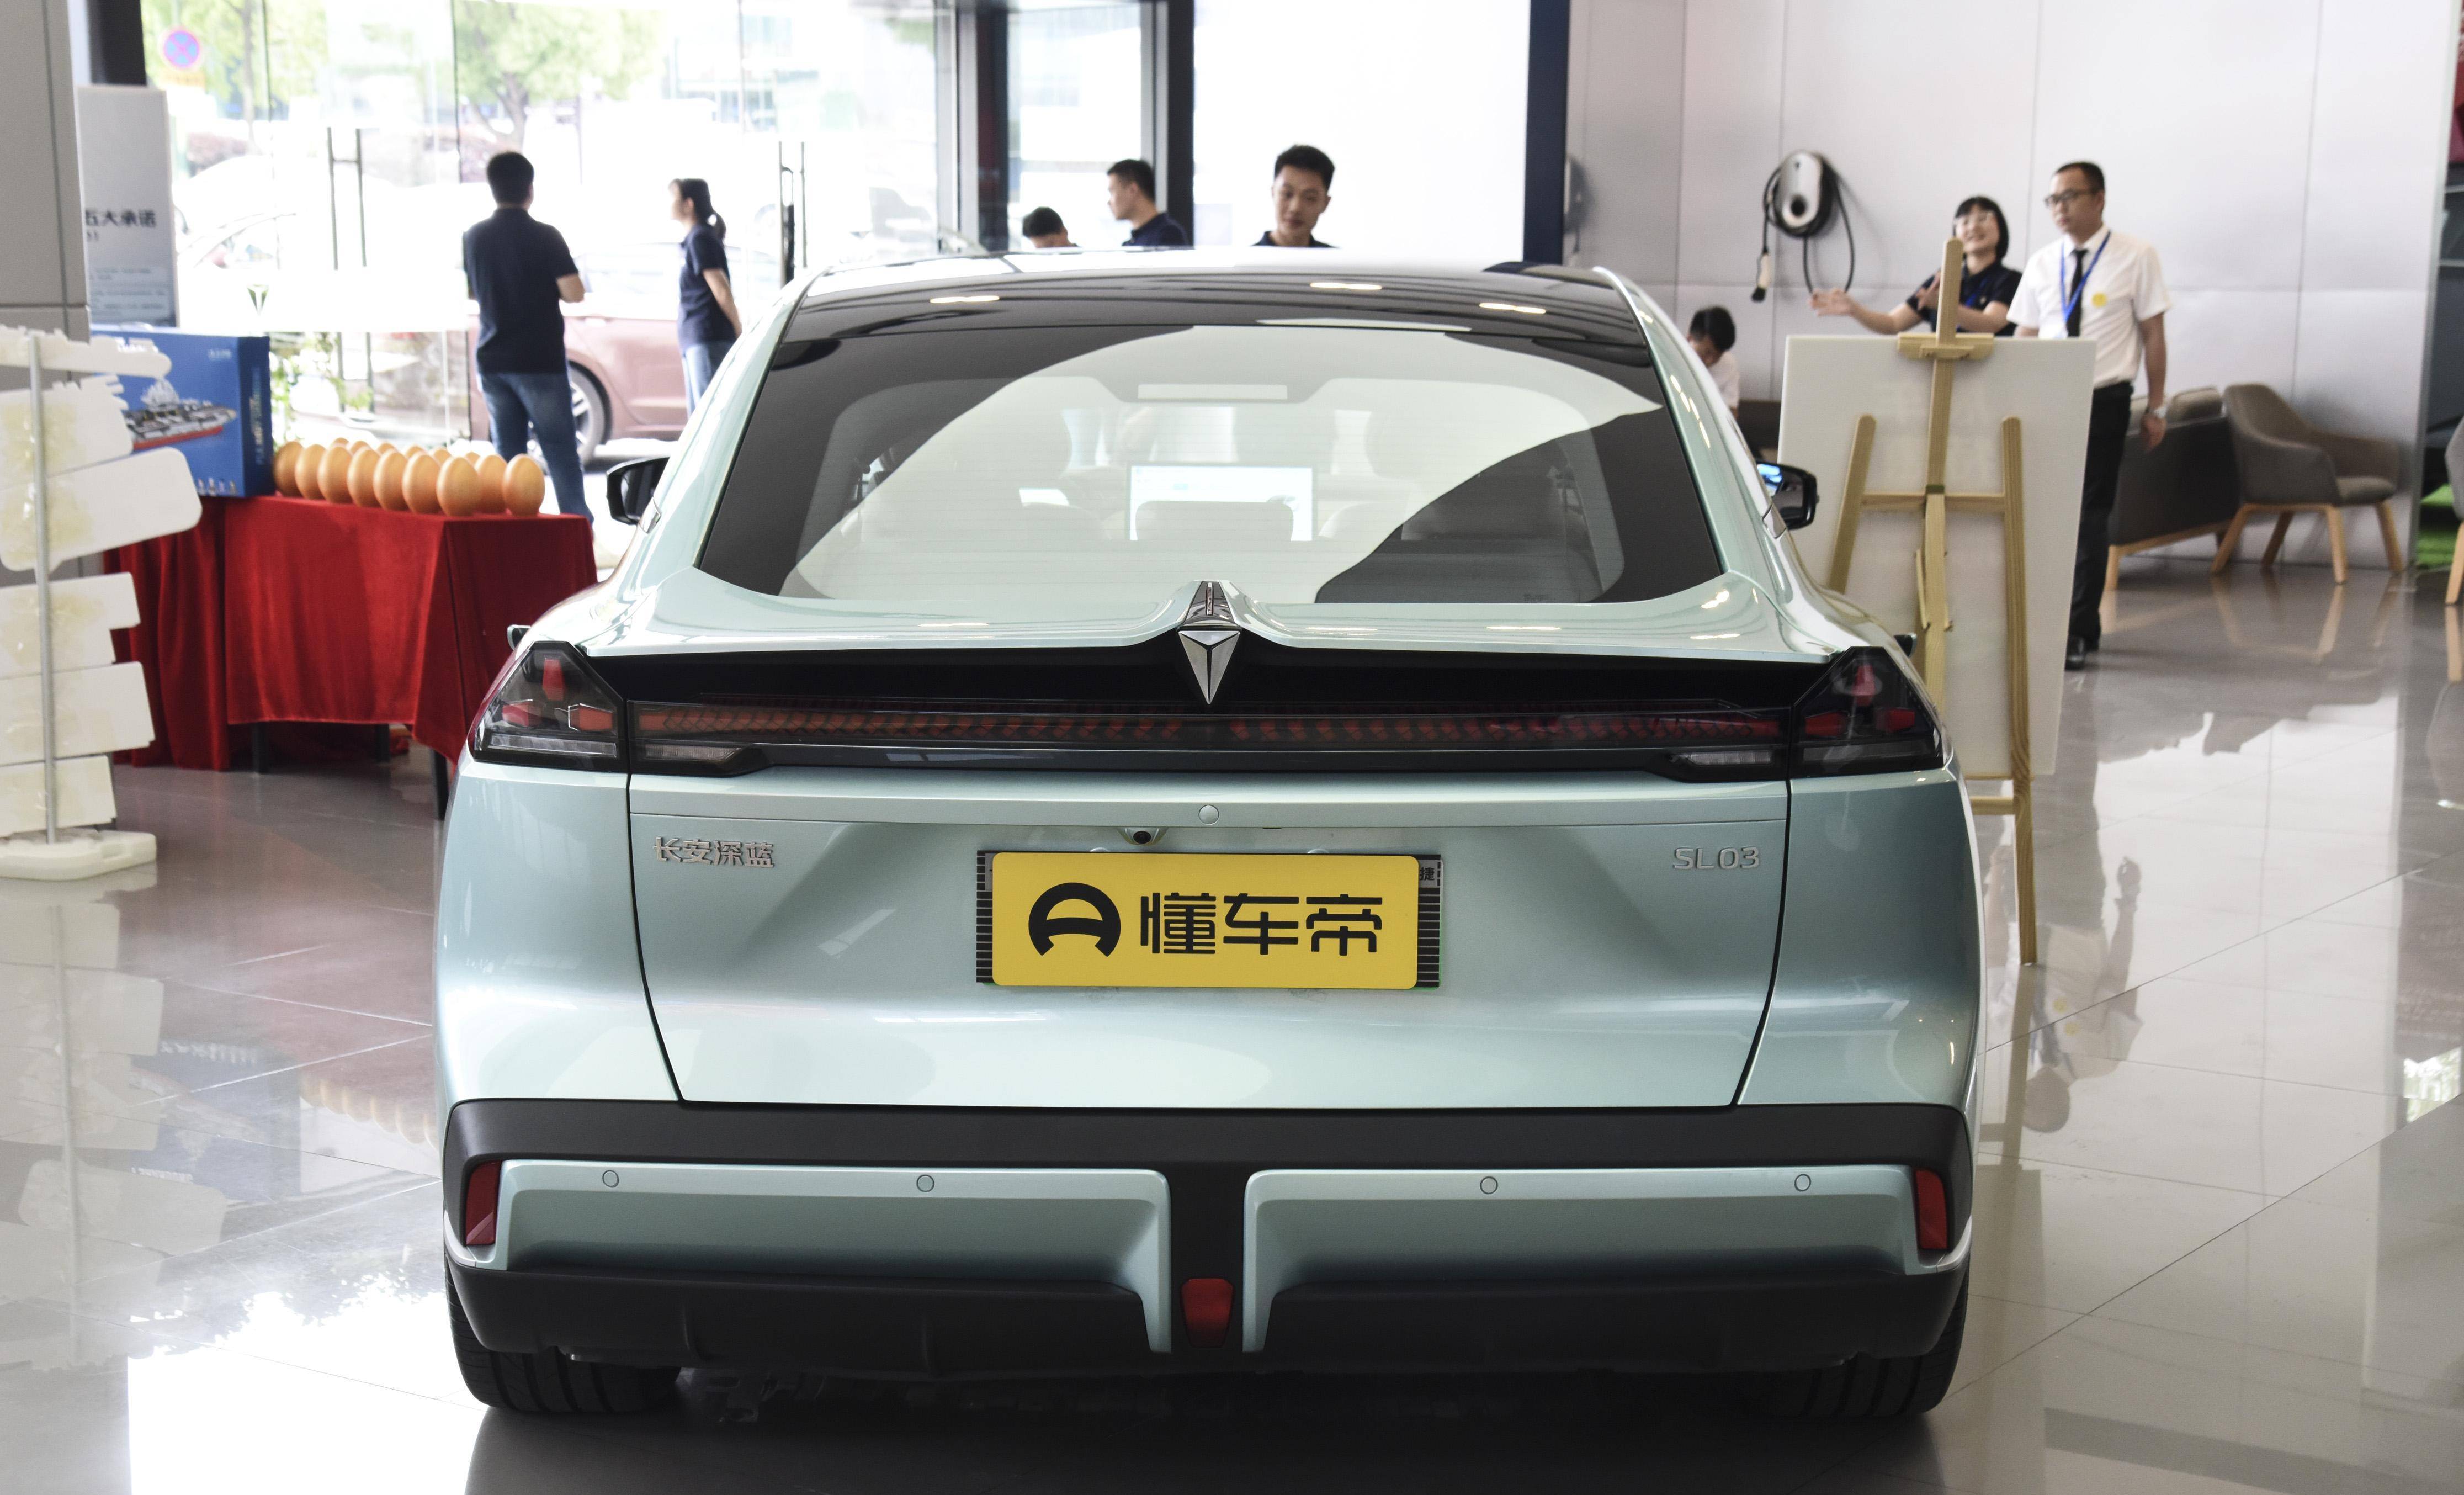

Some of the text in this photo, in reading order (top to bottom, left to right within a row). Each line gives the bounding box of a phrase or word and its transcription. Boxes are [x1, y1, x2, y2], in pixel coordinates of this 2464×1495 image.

[653, 837, 774, 868] 长安深蓝
[1672, 846, 1760, 870] SL03
[1140, 892, 1383, 956] 懂车帝
